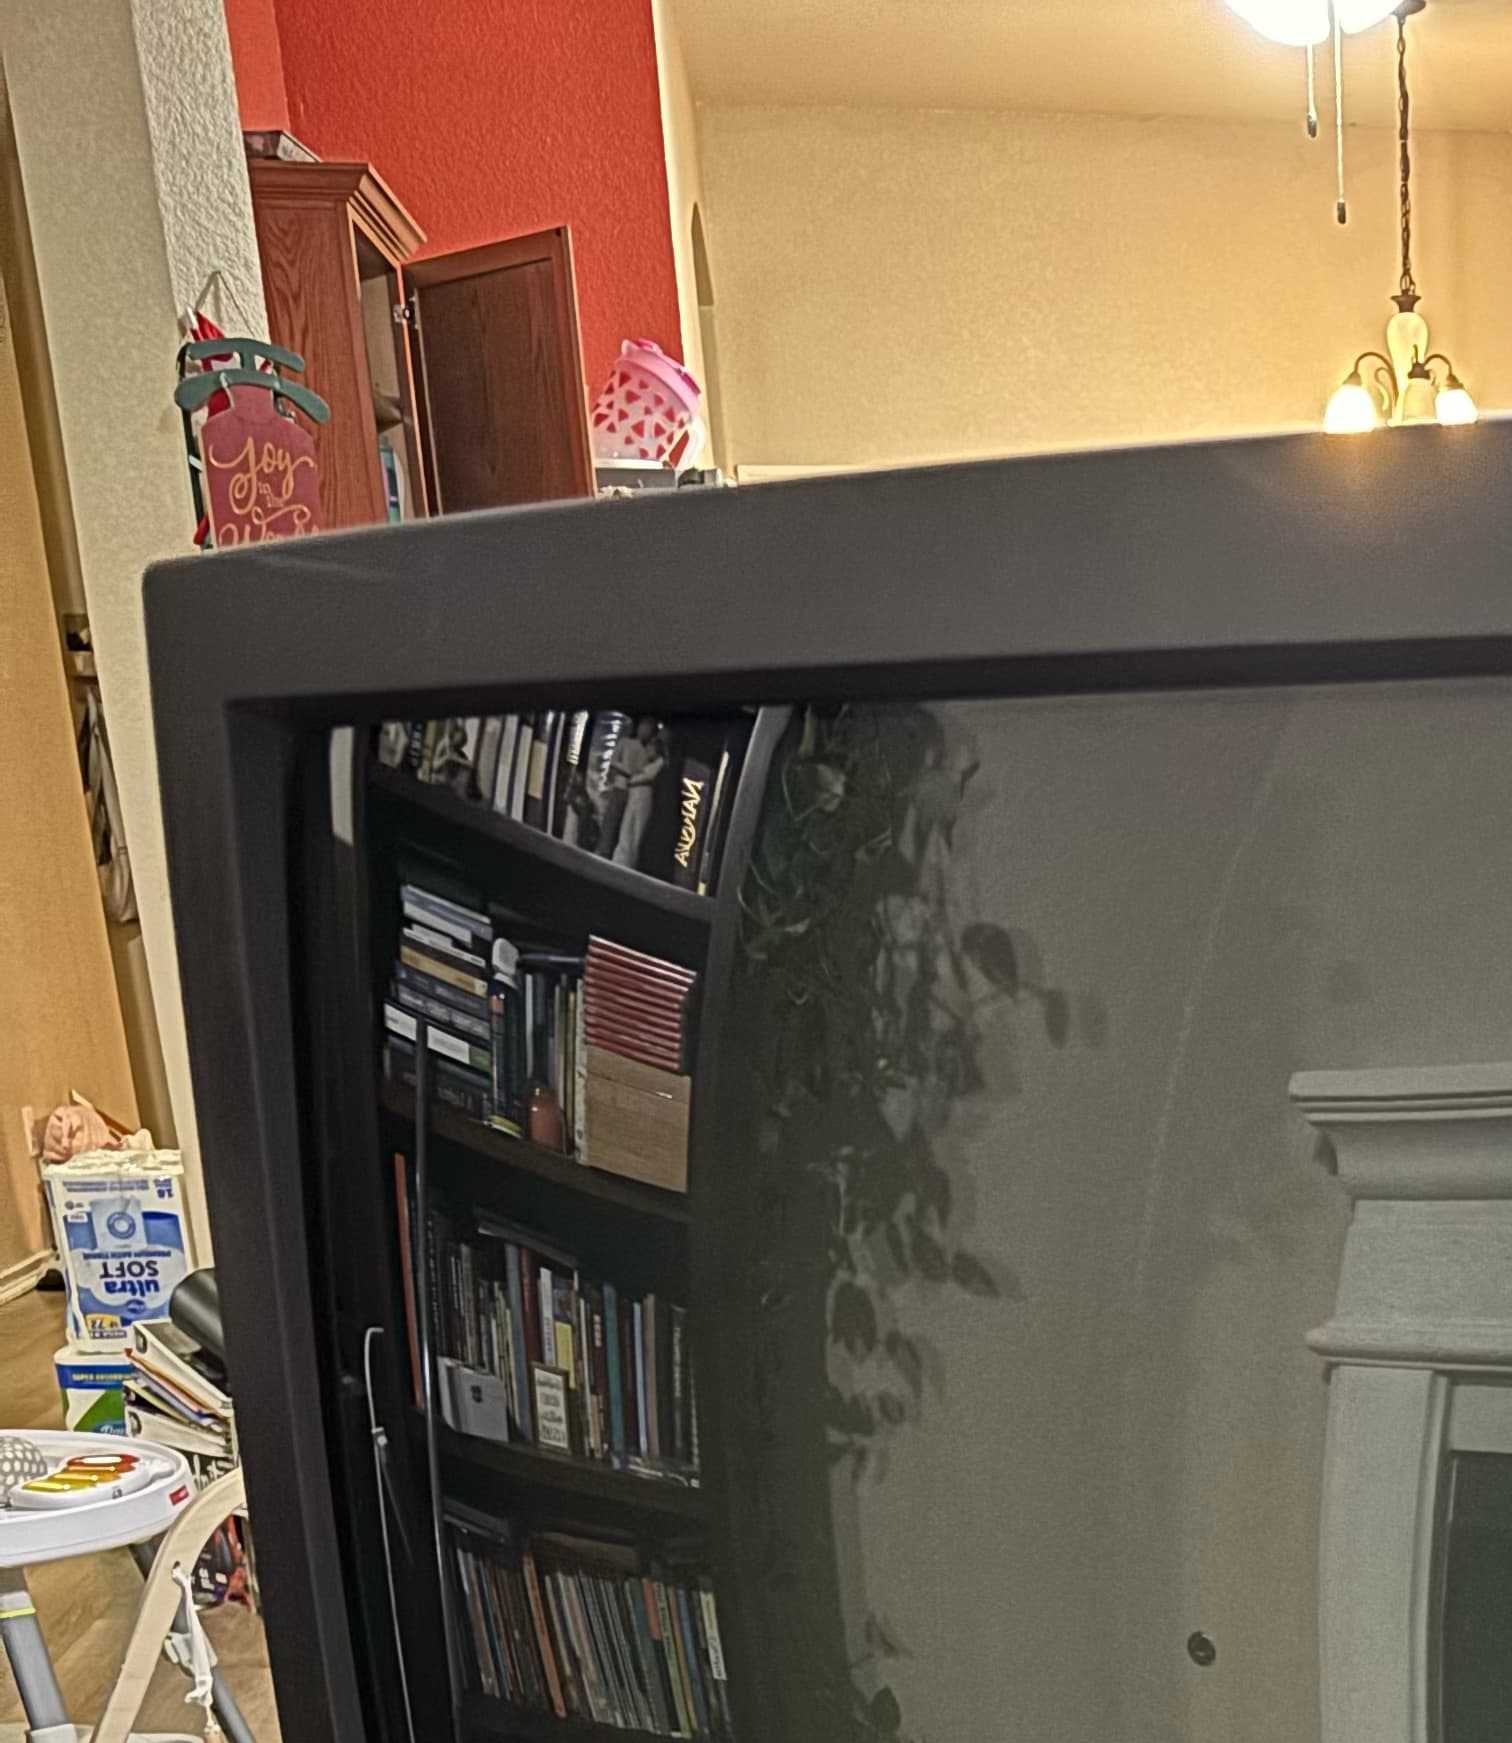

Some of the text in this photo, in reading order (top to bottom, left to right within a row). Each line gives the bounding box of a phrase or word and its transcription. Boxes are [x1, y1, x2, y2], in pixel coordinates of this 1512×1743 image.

[209, 436, 314, 515] Joy
[99, 1260, 159, 1279] SOFT
[103, 1279, 160, 1297] ultra
